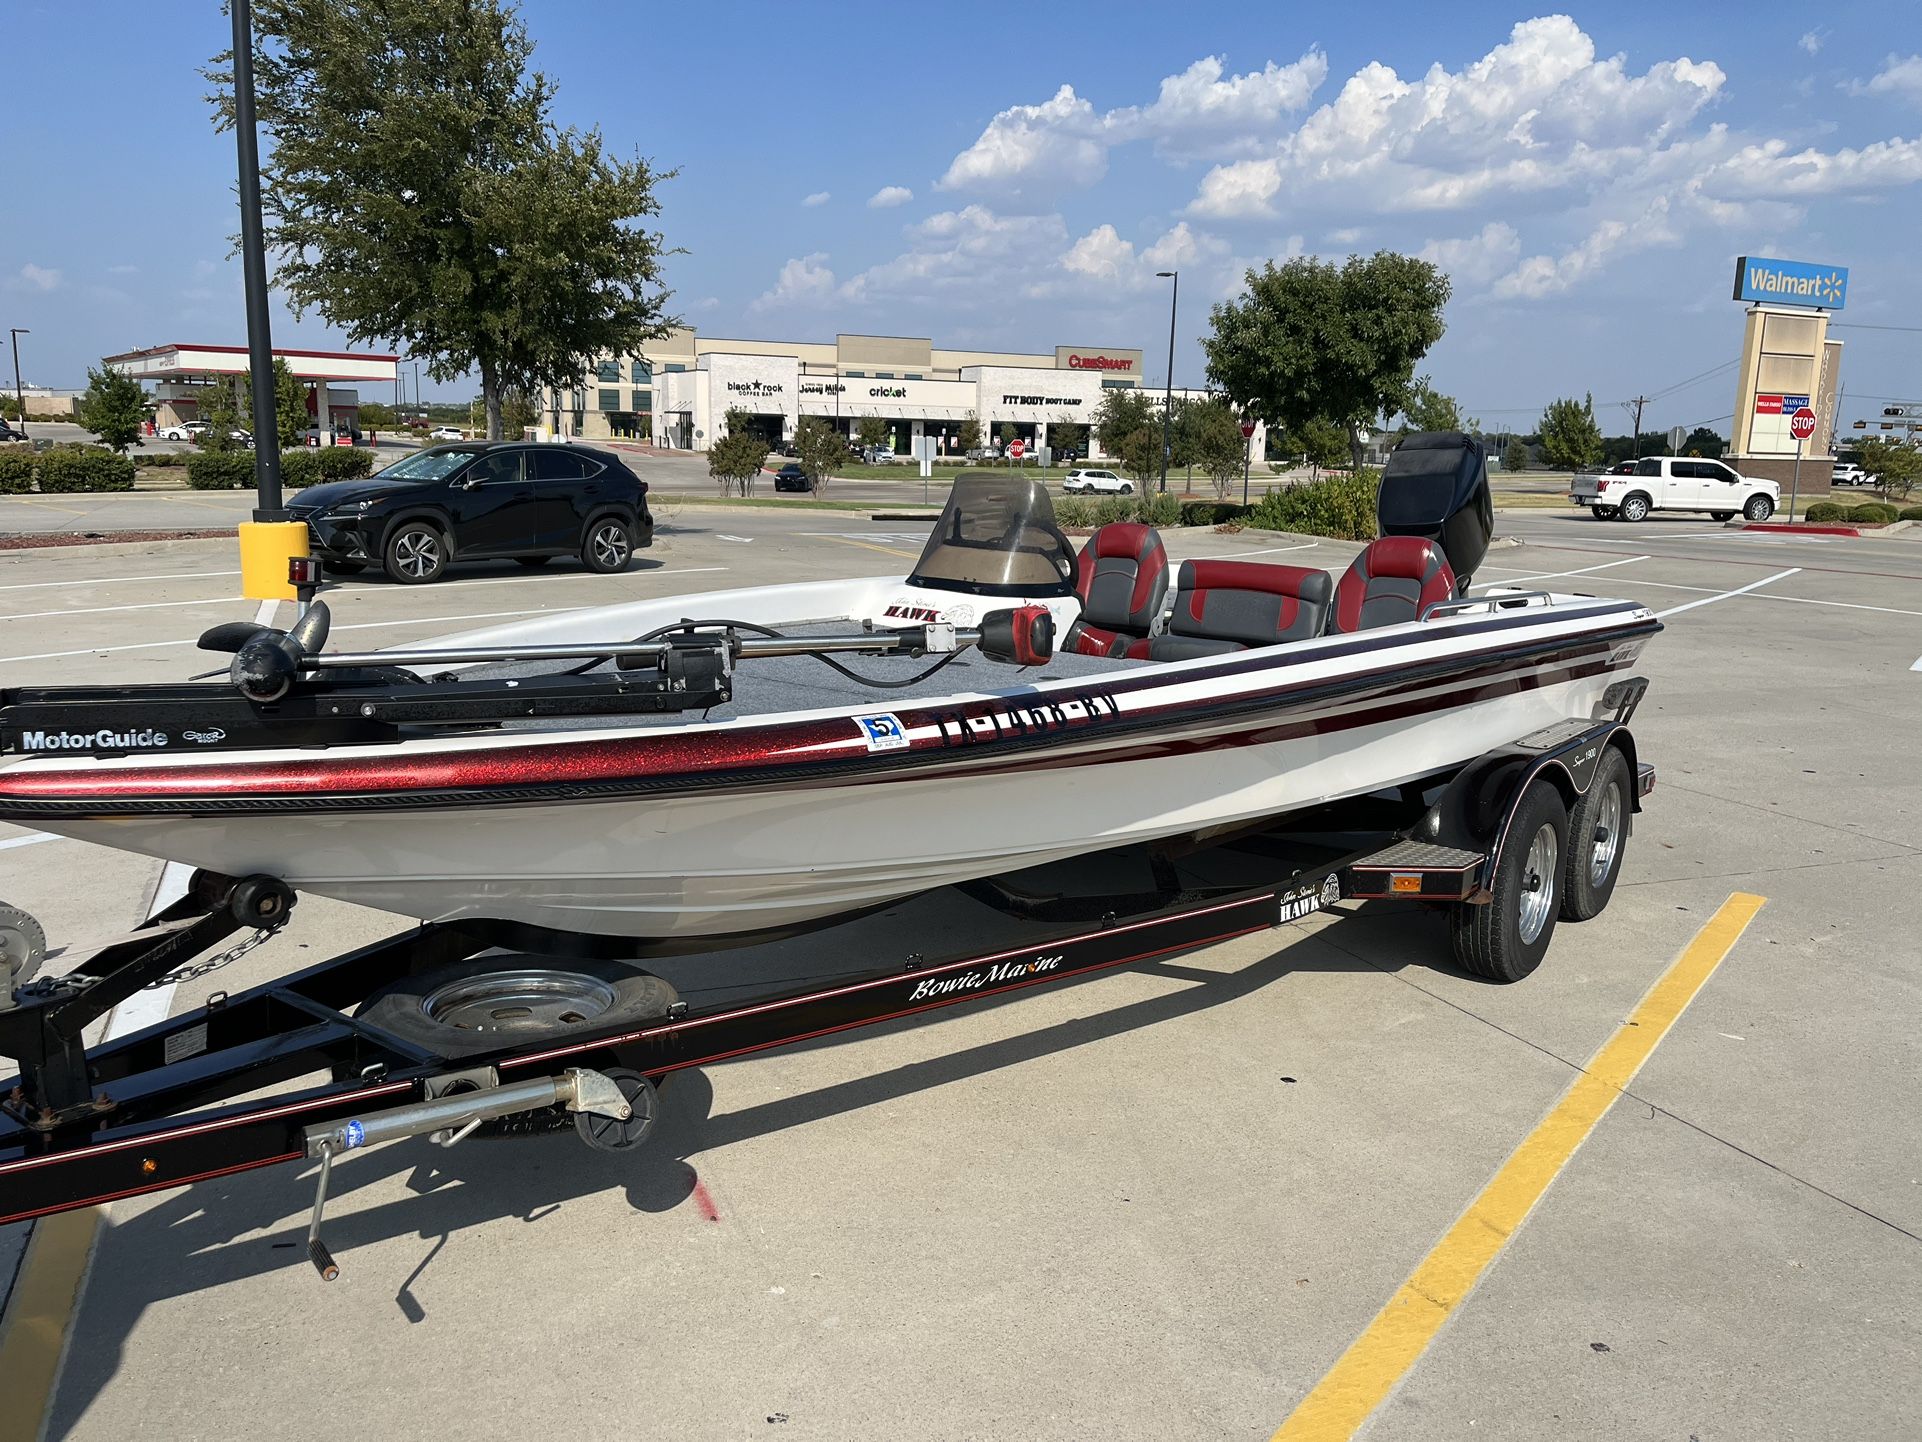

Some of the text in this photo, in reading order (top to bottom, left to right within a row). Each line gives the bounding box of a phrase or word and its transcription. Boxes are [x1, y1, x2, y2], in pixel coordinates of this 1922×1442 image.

[1750, 267, 1822, 297] Walmart
[727, 381, 783, 393] black rock
[869, 387, 907, 398] cricket
[1003, 395, 1019, 404] FIT
[1020, 396, 1045, 405] BODY
[1792, 417, 1815, 430] STOP
[1010, 445, 1024, 453] STOP
[883, 606, 941, 623] HAWK
[22, 728, 169, 750] MotorGuide
[1280, 894, 1320, 922] HAWK
[909, 955, 1064, 1001] Bowie Marine
